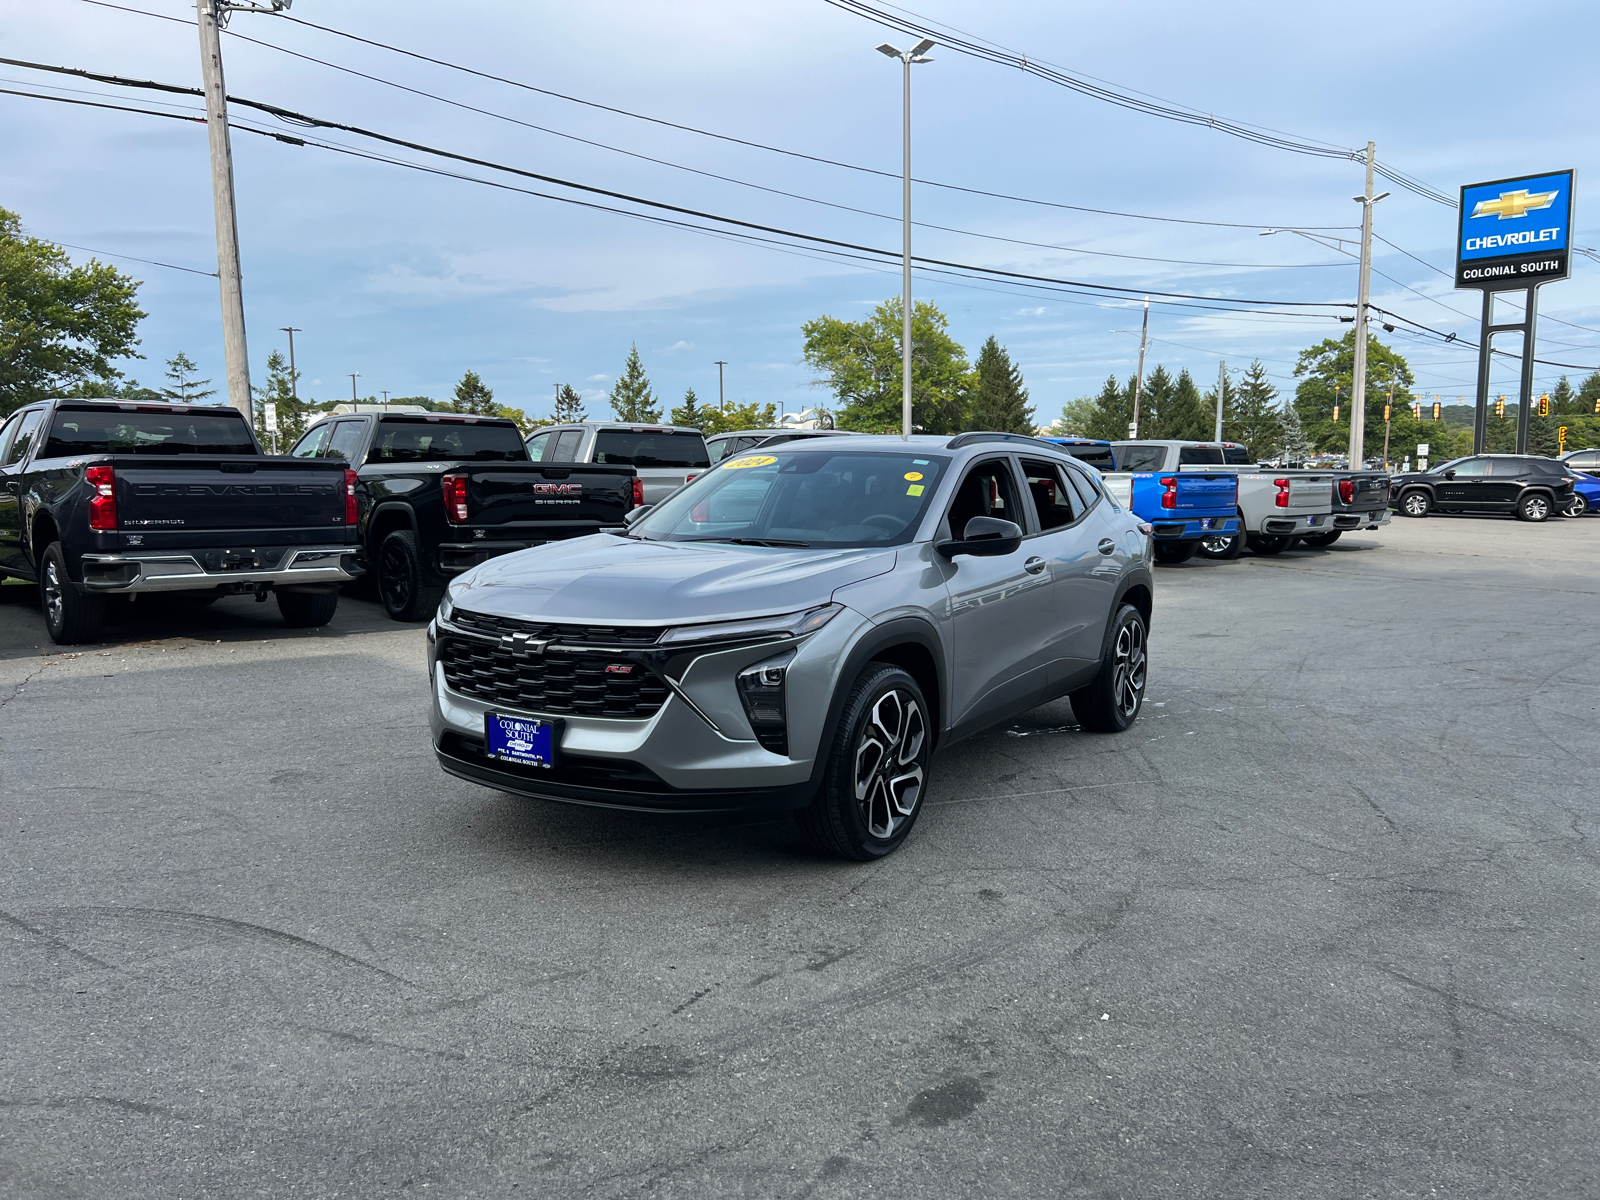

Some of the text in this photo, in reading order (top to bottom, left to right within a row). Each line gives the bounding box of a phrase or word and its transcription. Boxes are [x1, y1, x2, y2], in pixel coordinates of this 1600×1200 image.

[1466, 227, 1560, 251] CHEVROLET
[1463, 260, 1559, 279] COLONIAL SOUTH
[135, 485, 334, 496] CHEVROLET
[534, 483, 582, 495] GMC
[605, 665, 633, 673] RS
[500, 720, 539, 734] COLONIAL
[506, 730, 533, 742] SOUTH
[523, 759, 538, 767] SOUTH
